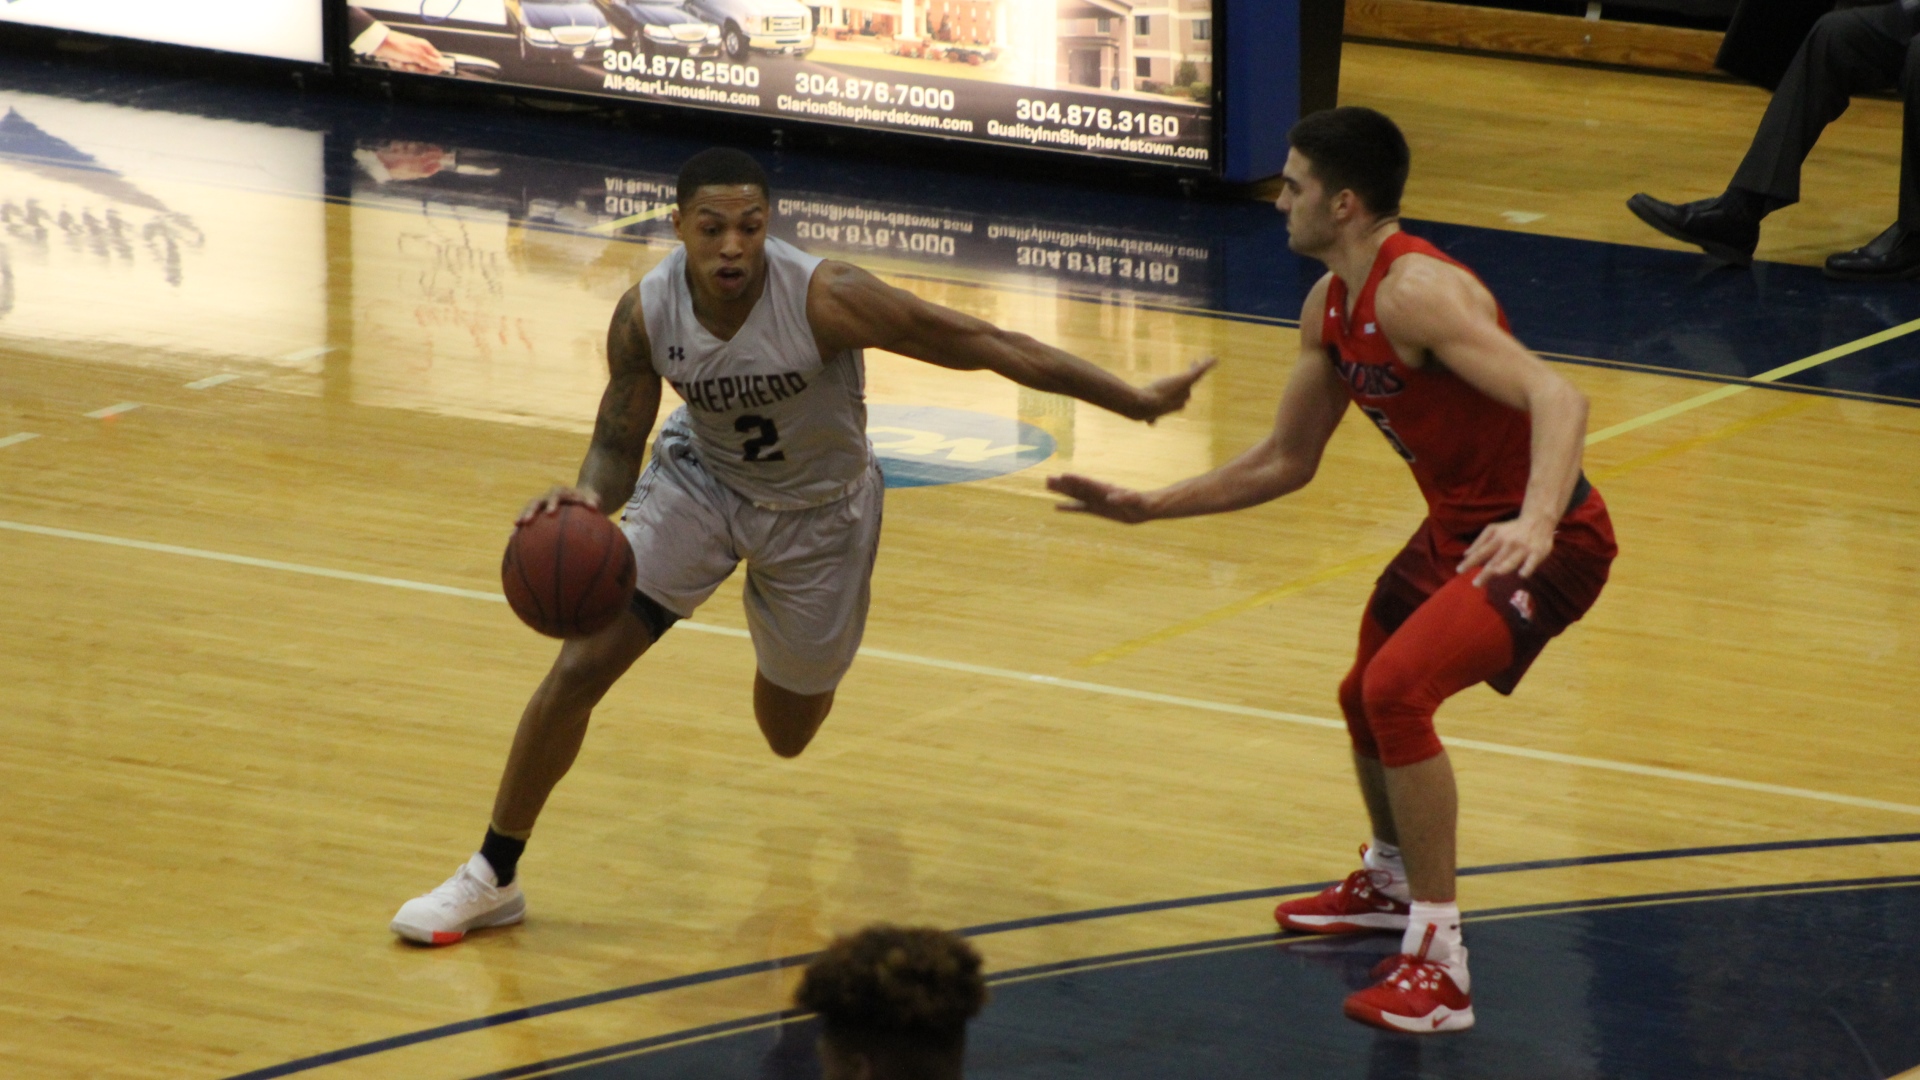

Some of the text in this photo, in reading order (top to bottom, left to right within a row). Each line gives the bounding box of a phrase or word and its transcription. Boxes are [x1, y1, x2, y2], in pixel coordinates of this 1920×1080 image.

[602, 49, 760, 87] 304.876.2500
[602, 74, 761, 107] All-StarLimousine.com
[794, 72, 955, 111] 304.876.7000
[776, 94, 974, 133] ClarionShepherdstown.com
[1016, 98, 1179, 137] 304.876.3160
[986, 119, 1209, 161] QualityInnShepherdstown.com
[734, 414, 786, 462] 2
